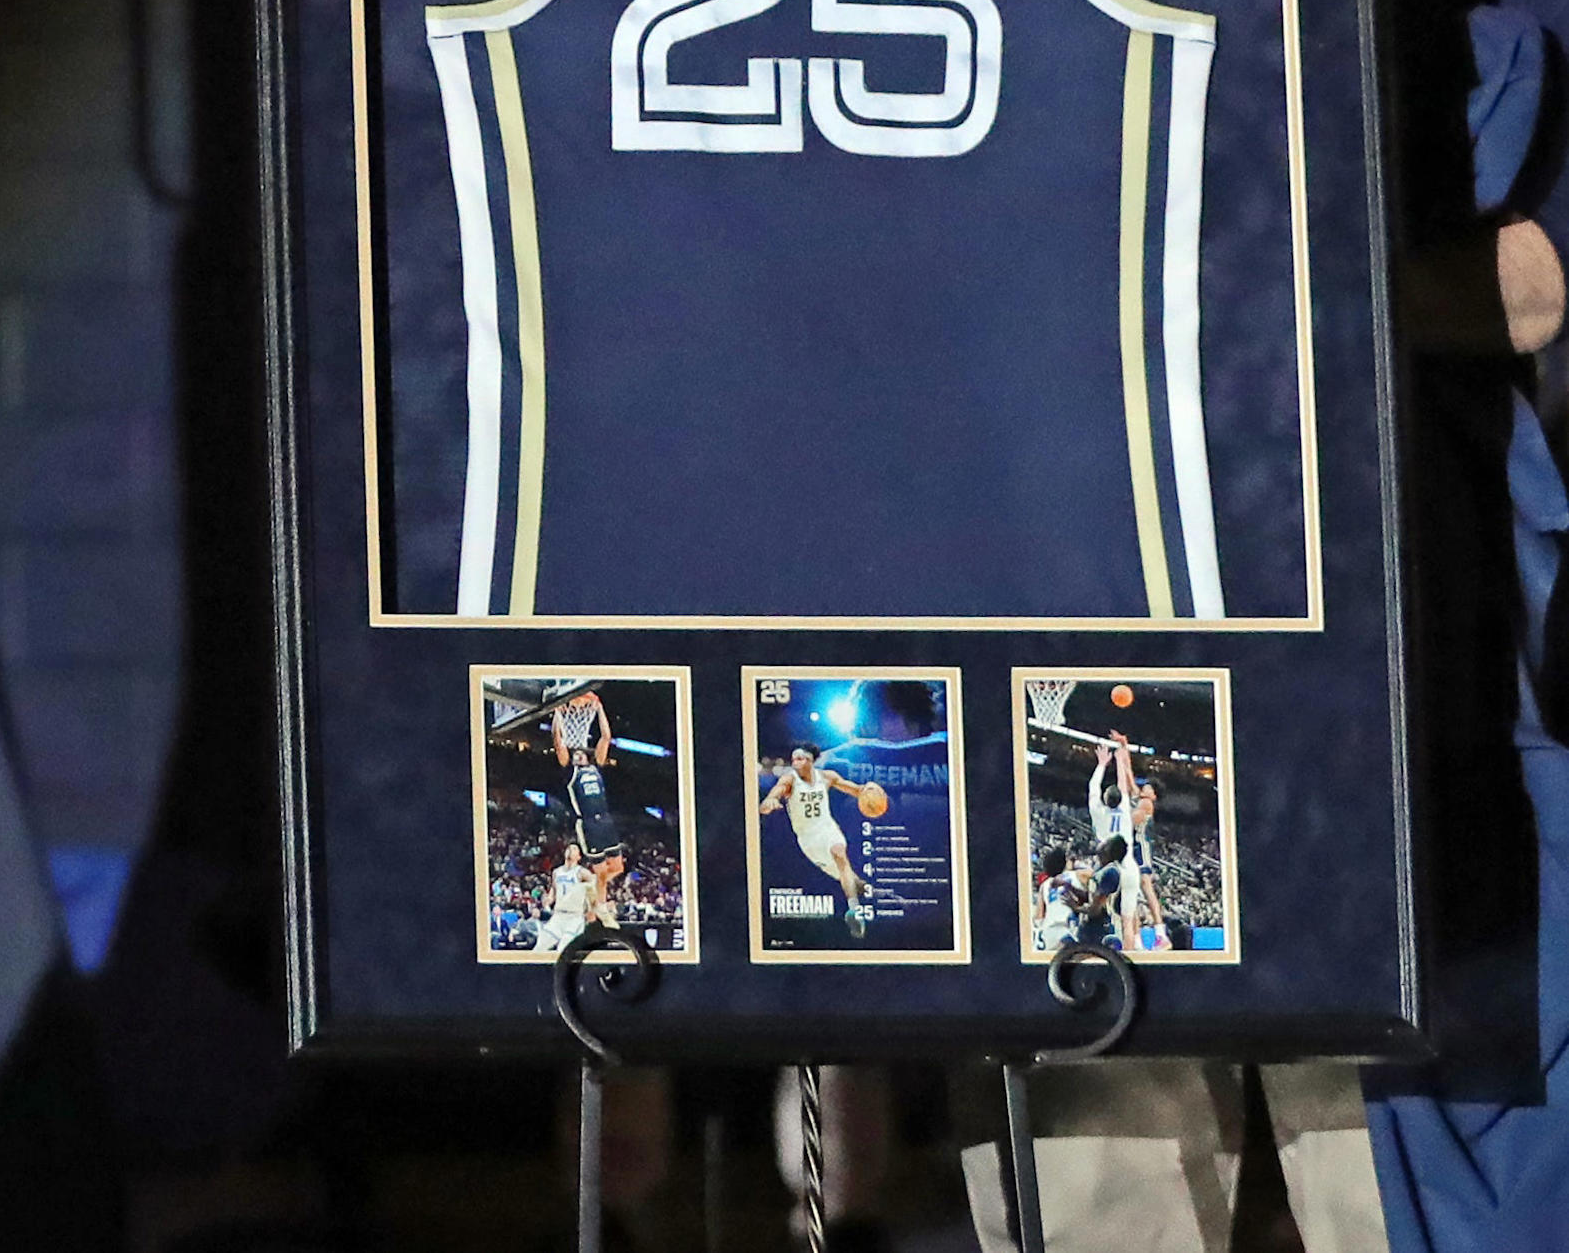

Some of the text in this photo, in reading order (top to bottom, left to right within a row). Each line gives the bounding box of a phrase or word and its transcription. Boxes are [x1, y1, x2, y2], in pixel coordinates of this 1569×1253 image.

[760, 679, 791, 704] 25
[848, 762, 949, 787] FREEMAN
[799, 791, 824, 802] ZIPS
[804, 803, 821, 818] 25
[769, 894, 835, 916] FREEMAN
[854, 905, 874, 920] 25
